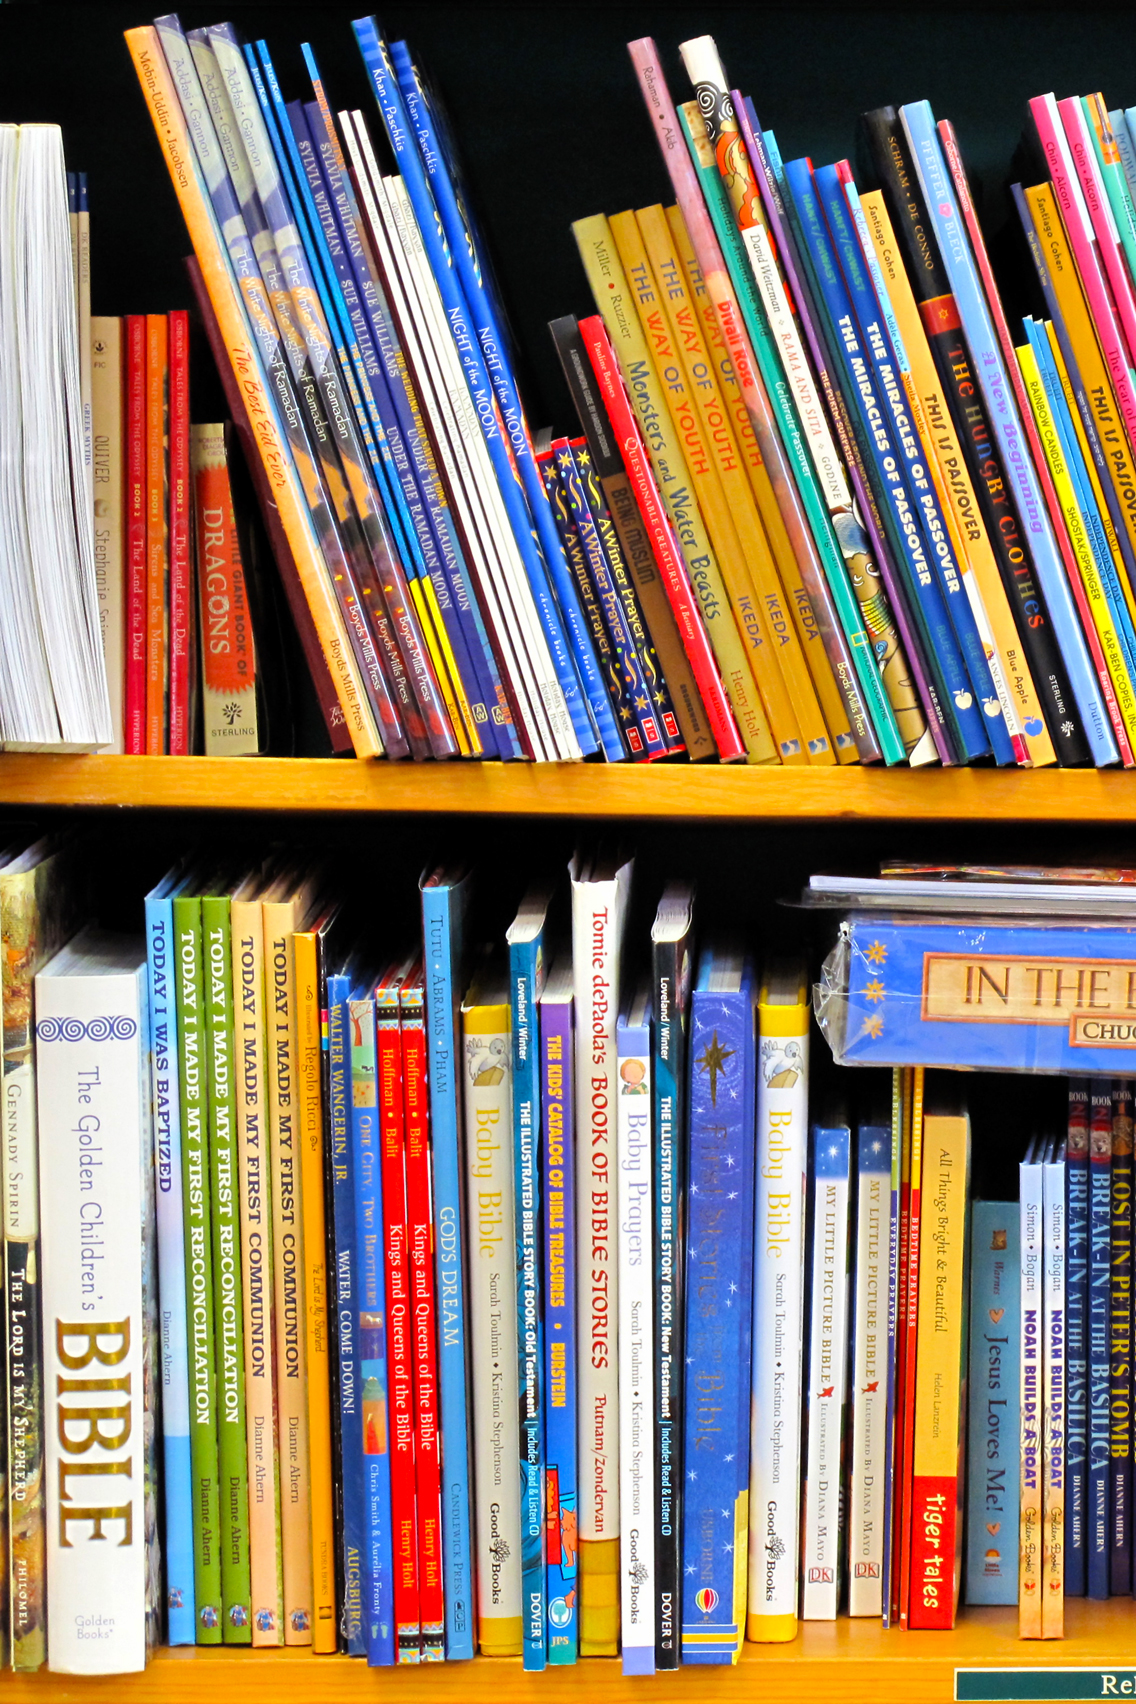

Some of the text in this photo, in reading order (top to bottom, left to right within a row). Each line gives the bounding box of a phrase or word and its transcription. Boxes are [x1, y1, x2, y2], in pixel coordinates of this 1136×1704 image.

[137, 49, 188, 188] Mobin-Uddin Jacobsen
[372, 68, 404, 152] Khan Paschkis
[232, 341, 287, 492] The Best Eid Ever
[448, 307, 499, 438] NIGHT of the MOON
[627, 360, 722, 620] Monsters and Water Beasts
[838, 315, 933, 587] THE MIRACLES OF PASSOVER
[923, 394, 981, 542] THIS IS PASSOVER
[982, 351, 1043, 534] A New Beginning
[202, 507, 230, 655] DRAGONS
[625, 436, 682, 593] QUESTIONABLE CREATURES
[210, 726, 255, 736] STERLING
[330, 638, 366, 732] Boyds Mills Press
[591, 905, 609, 969] Tomie
[964, 964, 1011, 1006] IN
[1024, 966, 1112, 1010] THE
[151, 920, 172, 1193] TODAY I WAS BAPTIZED
[591, 1072, 609, 1147] BOOK
[181, 931, 209, 1426] TODAY I MADE MY FIRST RECONCILIATION
[591, 1190, 609, 1262] BIBLE
[592, 1155, 609, 1183] OF
[55, 1065, 132, 1549] The Golden Children's BIBLE
[338, 1250, 354, 1415] WATER, COME DOWN!
[413, 1224, 432, 1450] Kings and Queens of the Bible
[439, 1207, 459, 1347] GOD'S DREAM
[591, 1267, 609, 1369] STORIES
[591, 1394, 607, 1535] Putnam/Zondervan
[984, 1327, 1008, 1512] Jesus Loves Me!
[1024, 1310, 1037, 1489] NOAH BUILDS A BOAT
[347, 1546, 361, 1632] AUGSBURG
[423, 1519, 437, 1587] Henry Holt
[530, 1593, 541, 1636] DOVER
[923, 1493, 943, 1609] tiger tales
[75, 1616, 115, 1628] Golden
